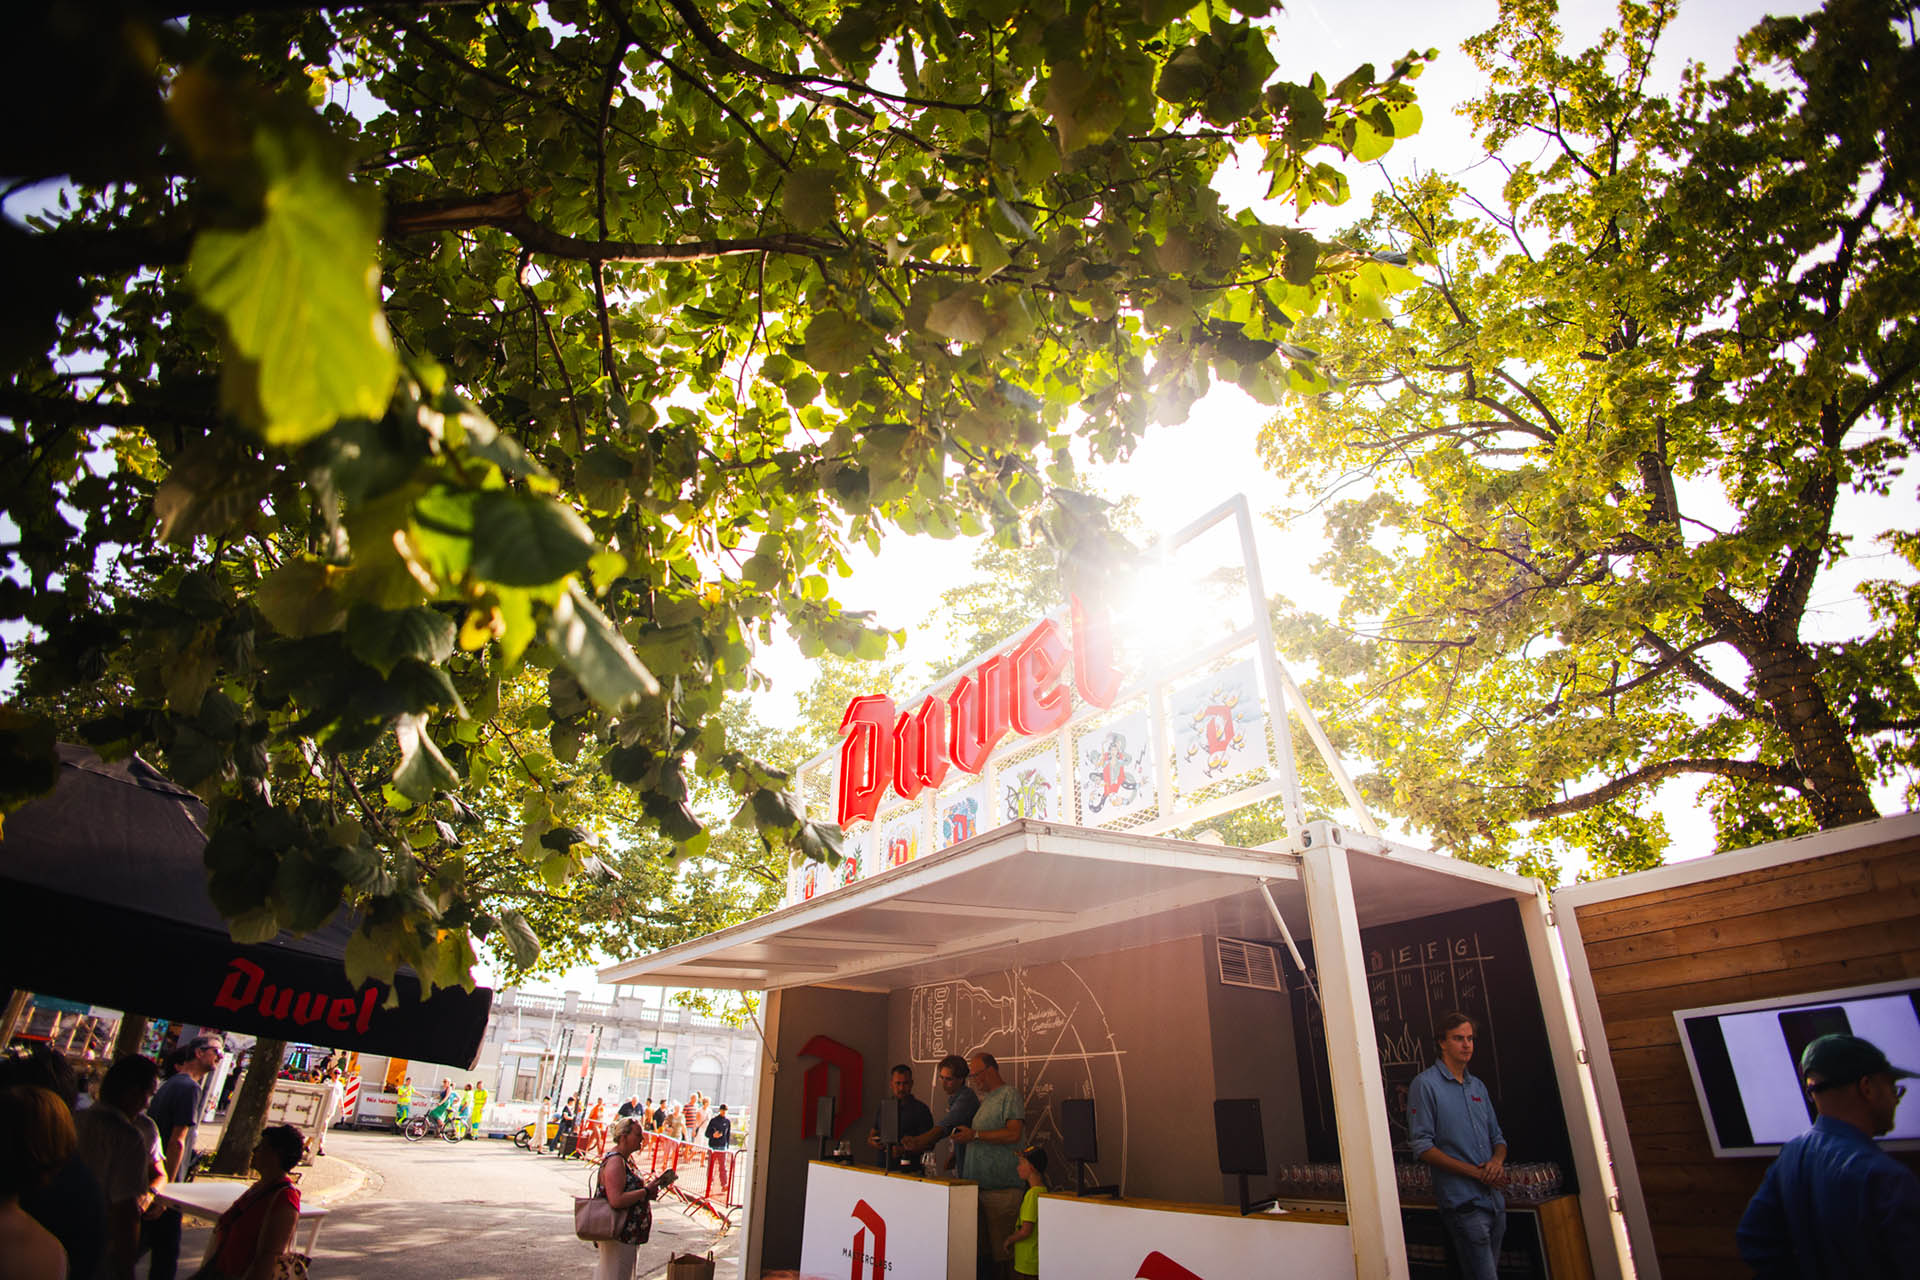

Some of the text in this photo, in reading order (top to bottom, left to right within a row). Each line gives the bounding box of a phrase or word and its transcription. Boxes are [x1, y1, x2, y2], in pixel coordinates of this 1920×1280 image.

[838, 593, 1123, 831] Duvel
[1399, 944, 1413, 964] E
[1427, 940, 1439, 960] F
[1454, 938, 1468, 956] G
[213, 957, 379, 1035] Duvel
[842, 1247, 893, 1272] MASTERCLASS
